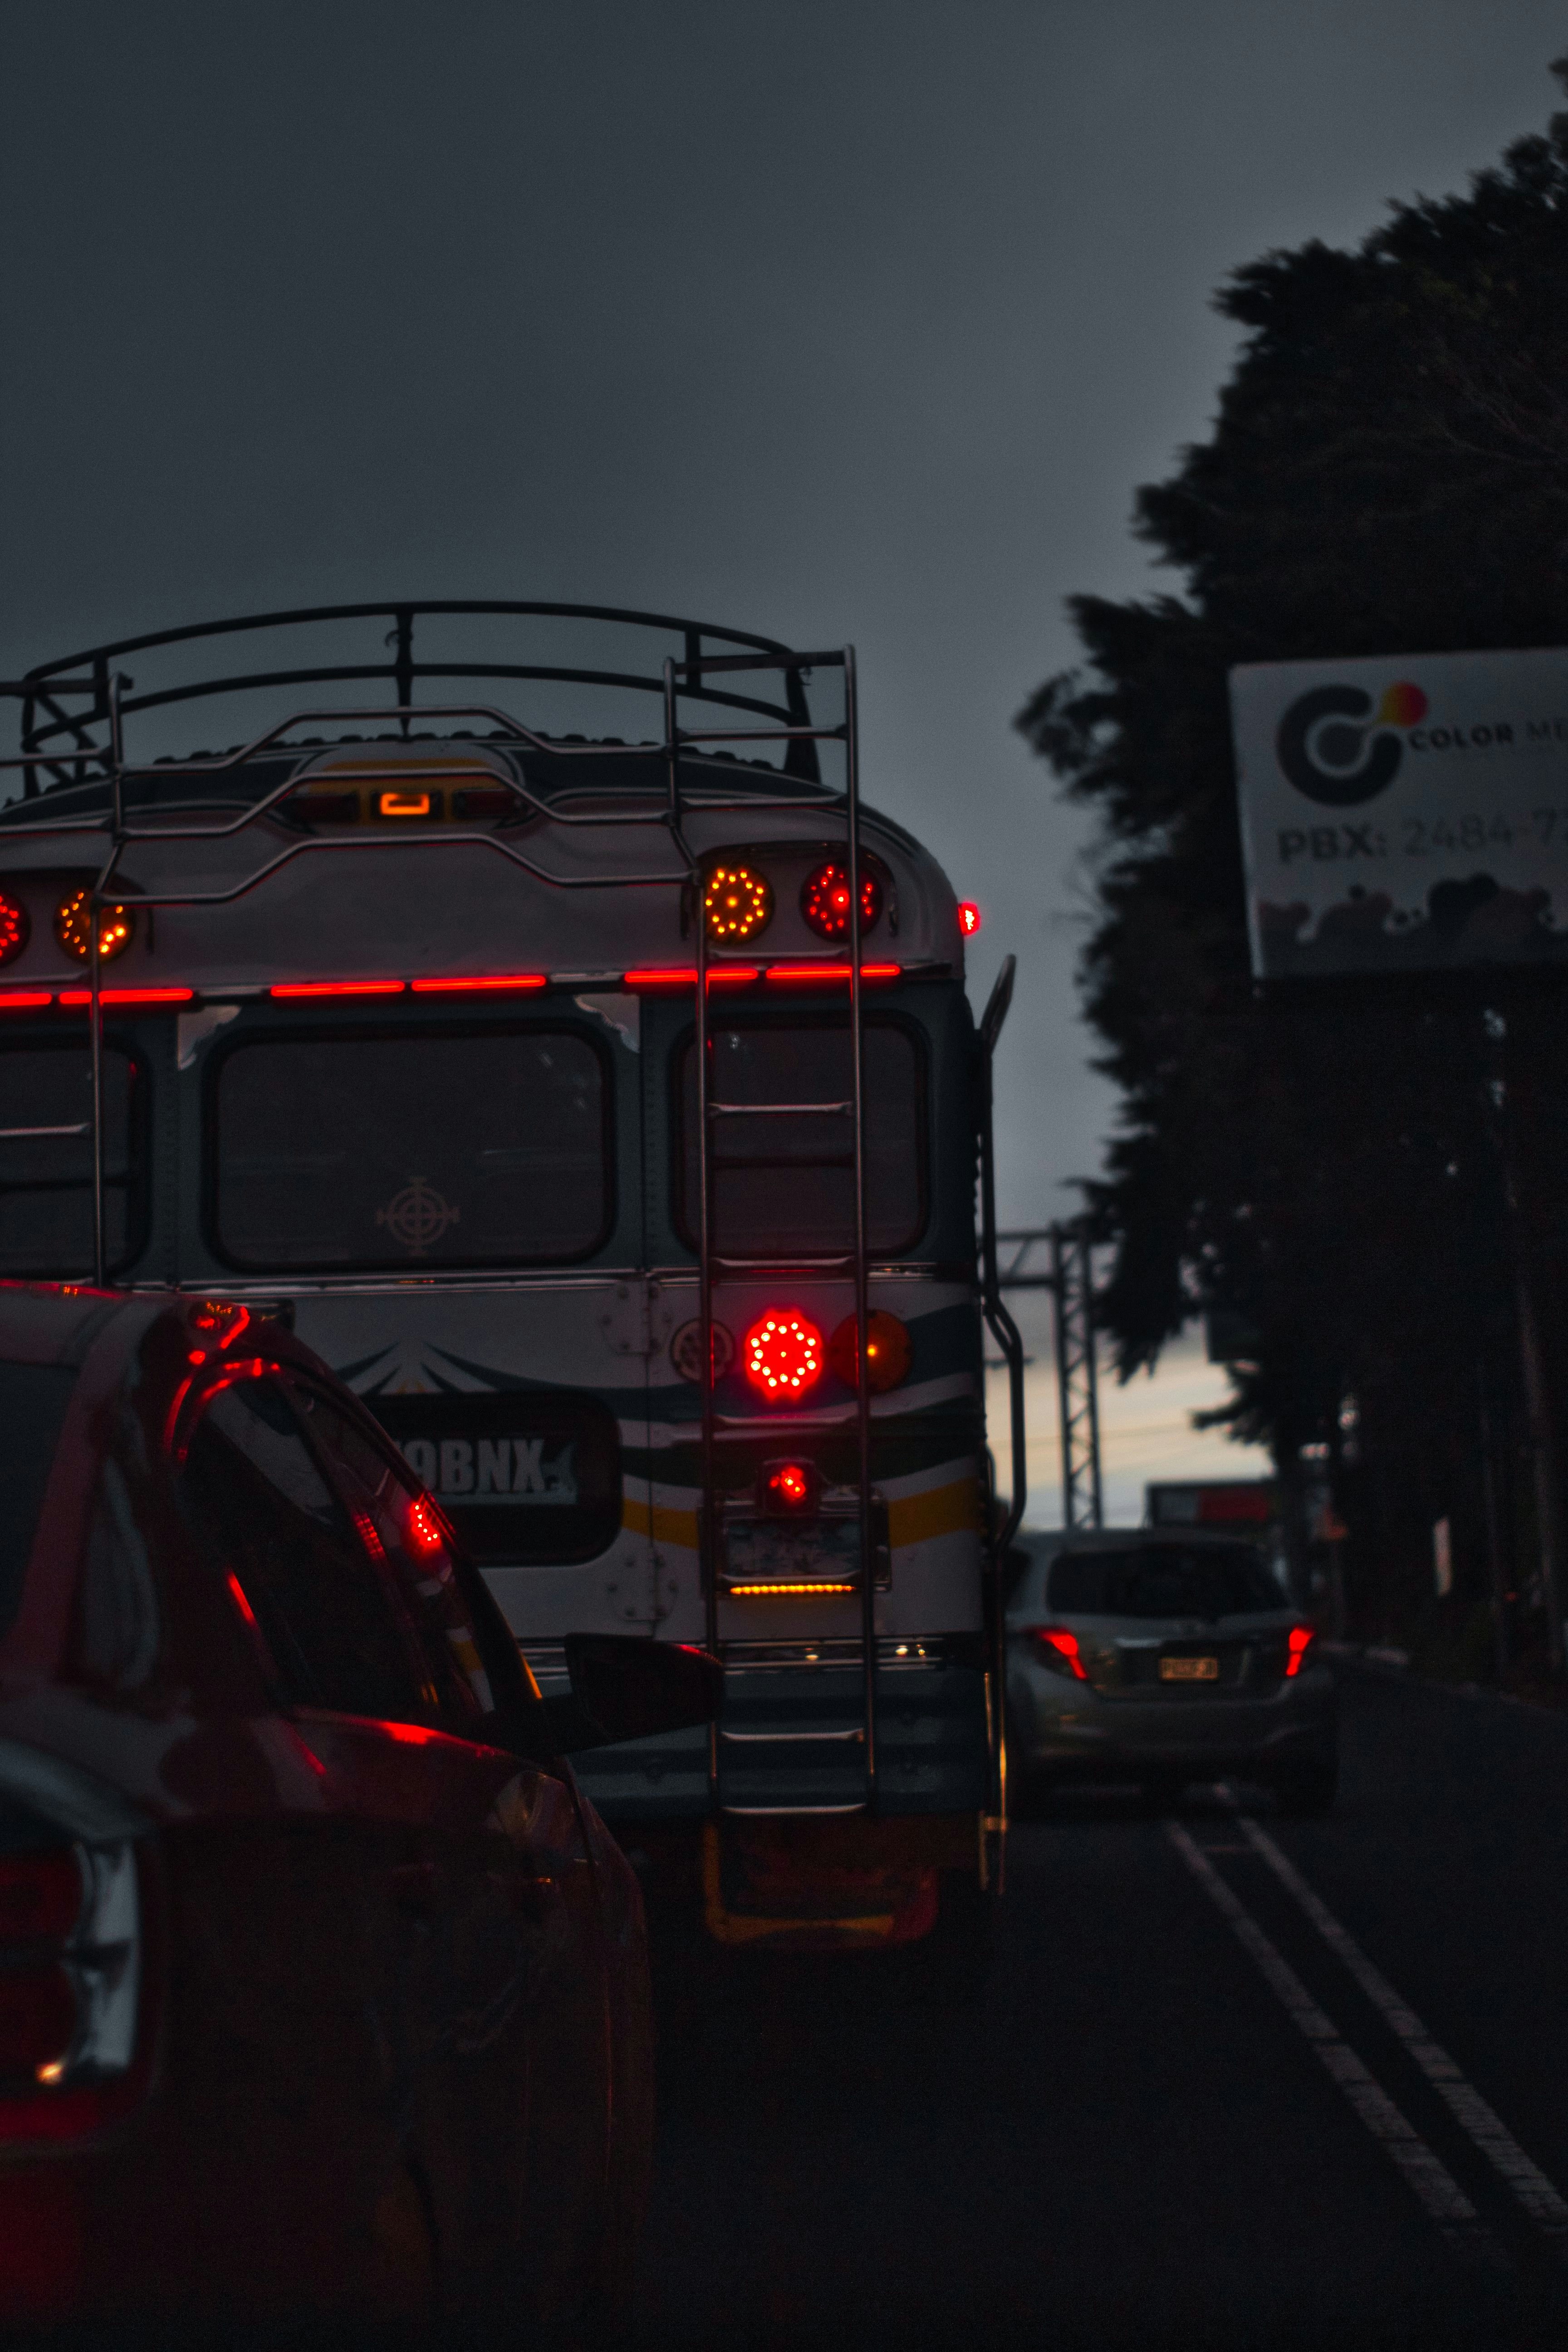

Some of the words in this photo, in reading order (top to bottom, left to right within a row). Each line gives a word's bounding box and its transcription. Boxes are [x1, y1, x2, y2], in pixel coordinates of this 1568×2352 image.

[1408, 722, 1514, 751] COLOR
[1277, 820, 1387, 863] PBX:
[1401, 808, 1568, 857] 2484-7
[392, 1439, 545, 1492] 9BNX
